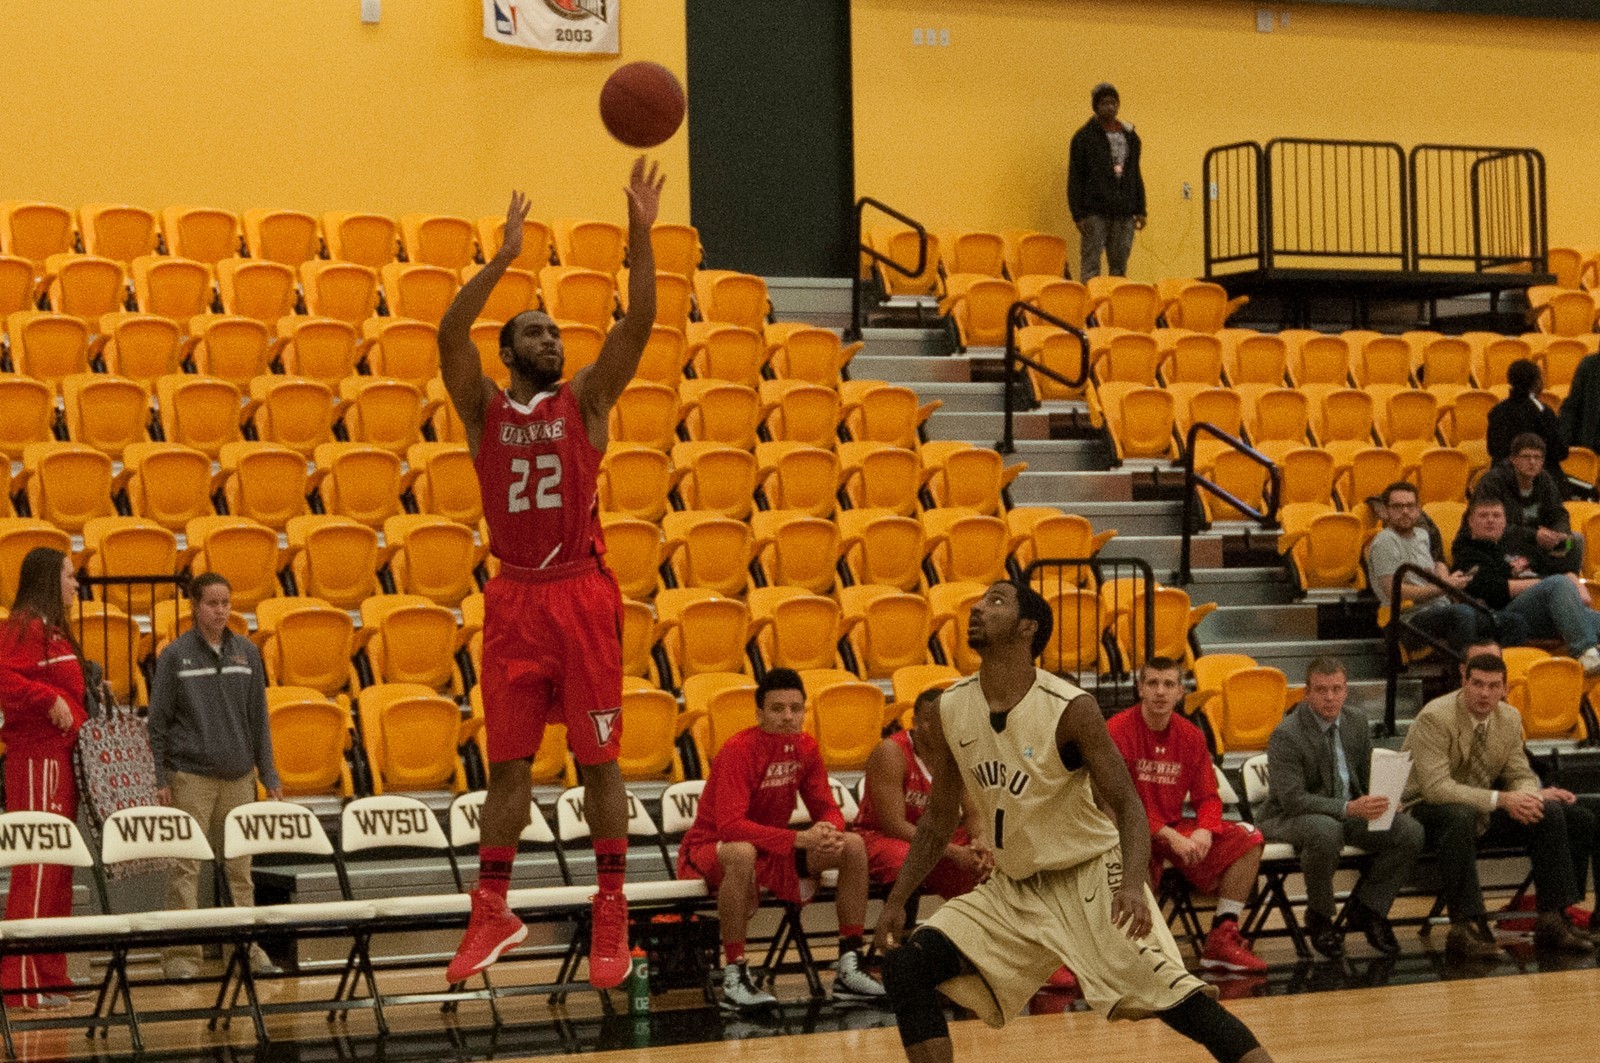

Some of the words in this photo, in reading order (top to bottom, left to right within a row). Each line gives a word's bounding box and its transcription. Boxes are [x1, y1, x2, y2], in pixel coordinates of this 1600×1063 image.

[556, 28, 593, 43] 2003
[508, 454, 563, 513] 22
[971, 760, 1030, 796] WVSU
[112, 815, 194, 842] WVSU
[234, 814, 313, 841] WVSU
[353, 809, 430, 836] WVSU
[994, 807, 1005, 850] 1
[0, 823, 72, 850] WVSU
